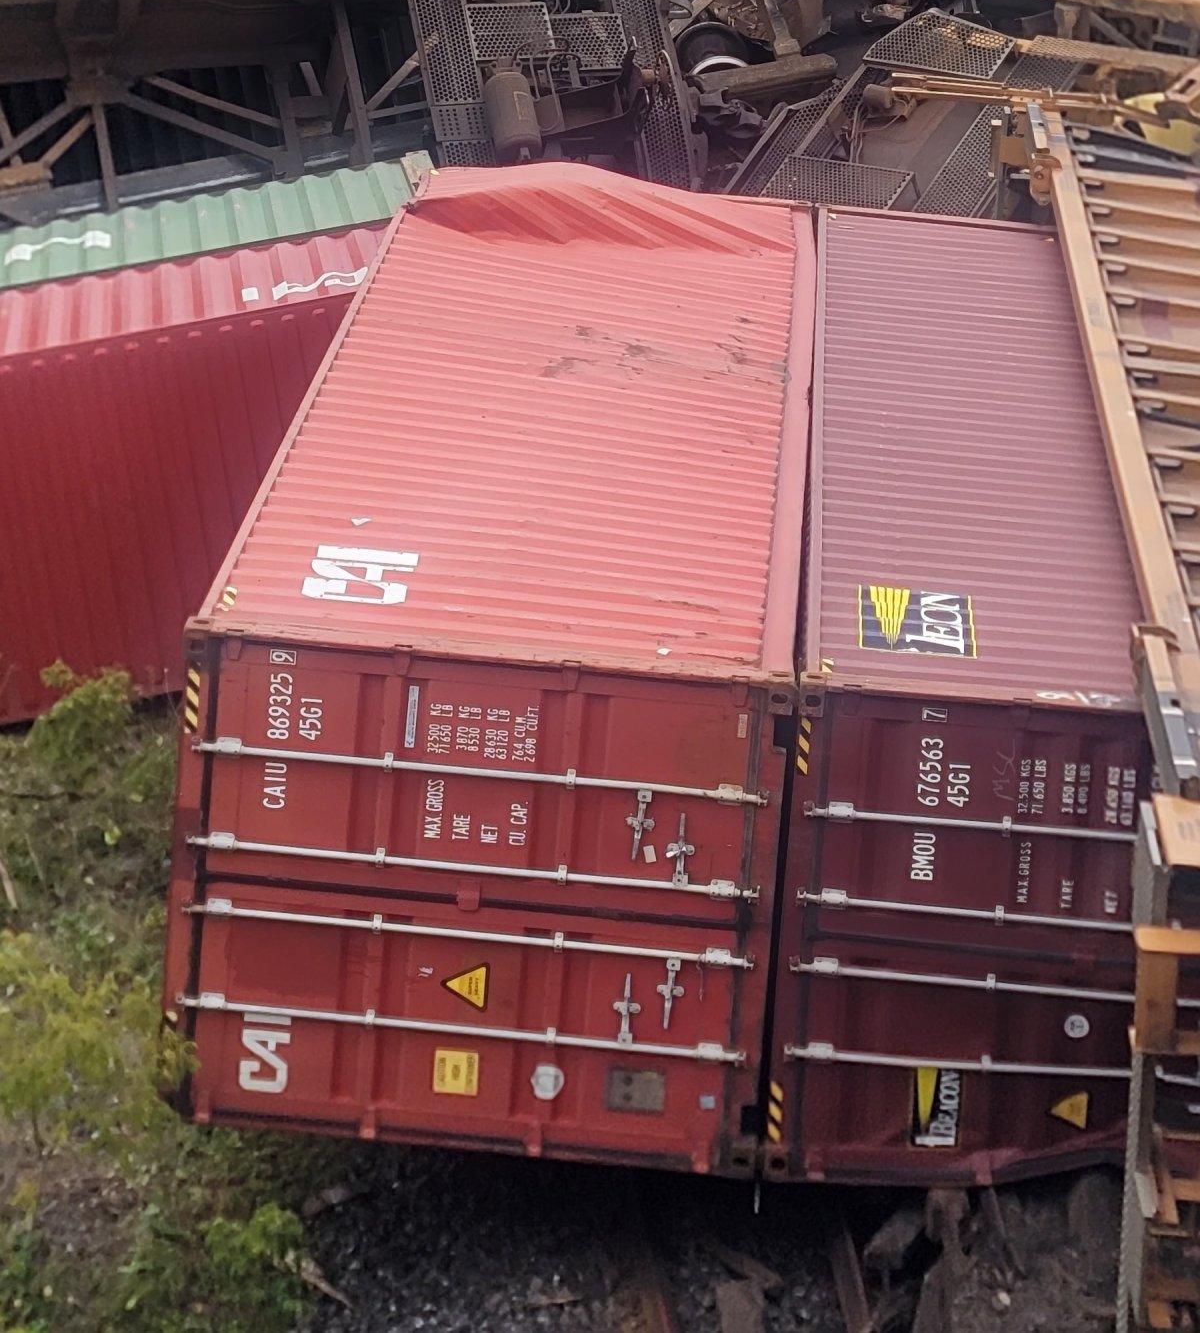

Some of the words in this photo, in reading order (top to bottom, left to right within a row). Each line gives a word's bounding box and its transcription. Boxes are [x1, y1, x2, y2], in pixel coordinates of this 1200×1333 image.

[267, 673, 293, 739] 869325
[431, 704, 441, 716] KG
[442, 705, 453, 716] LB
[459, 706, 470, 719] KG
[471, 707, 481, 719] LB
[487, 709, 498, 721] KG
[499, 709, 510, 722] LB
[299, 697, 322, 741] 45G1
[918, 738, 943, 806] 676563
[1020, 759, 1031, 778] KGS
[1035, 760, 1047, 778] LBS
[1064, 764, 1076, 782] KGS
[1079, 764, 1090, 781] LBS
[262, 762, 288, 809] CAIU
[947, 763, 971, 807] 45G1
[452, 815, 470, 840] TARE
[481, 825, 498, 844] NET
[911, 831, 935, 881] BMOU
[1061, 879, 1074, 909] TARE
[239, 1013, 291, 1093] CAI
